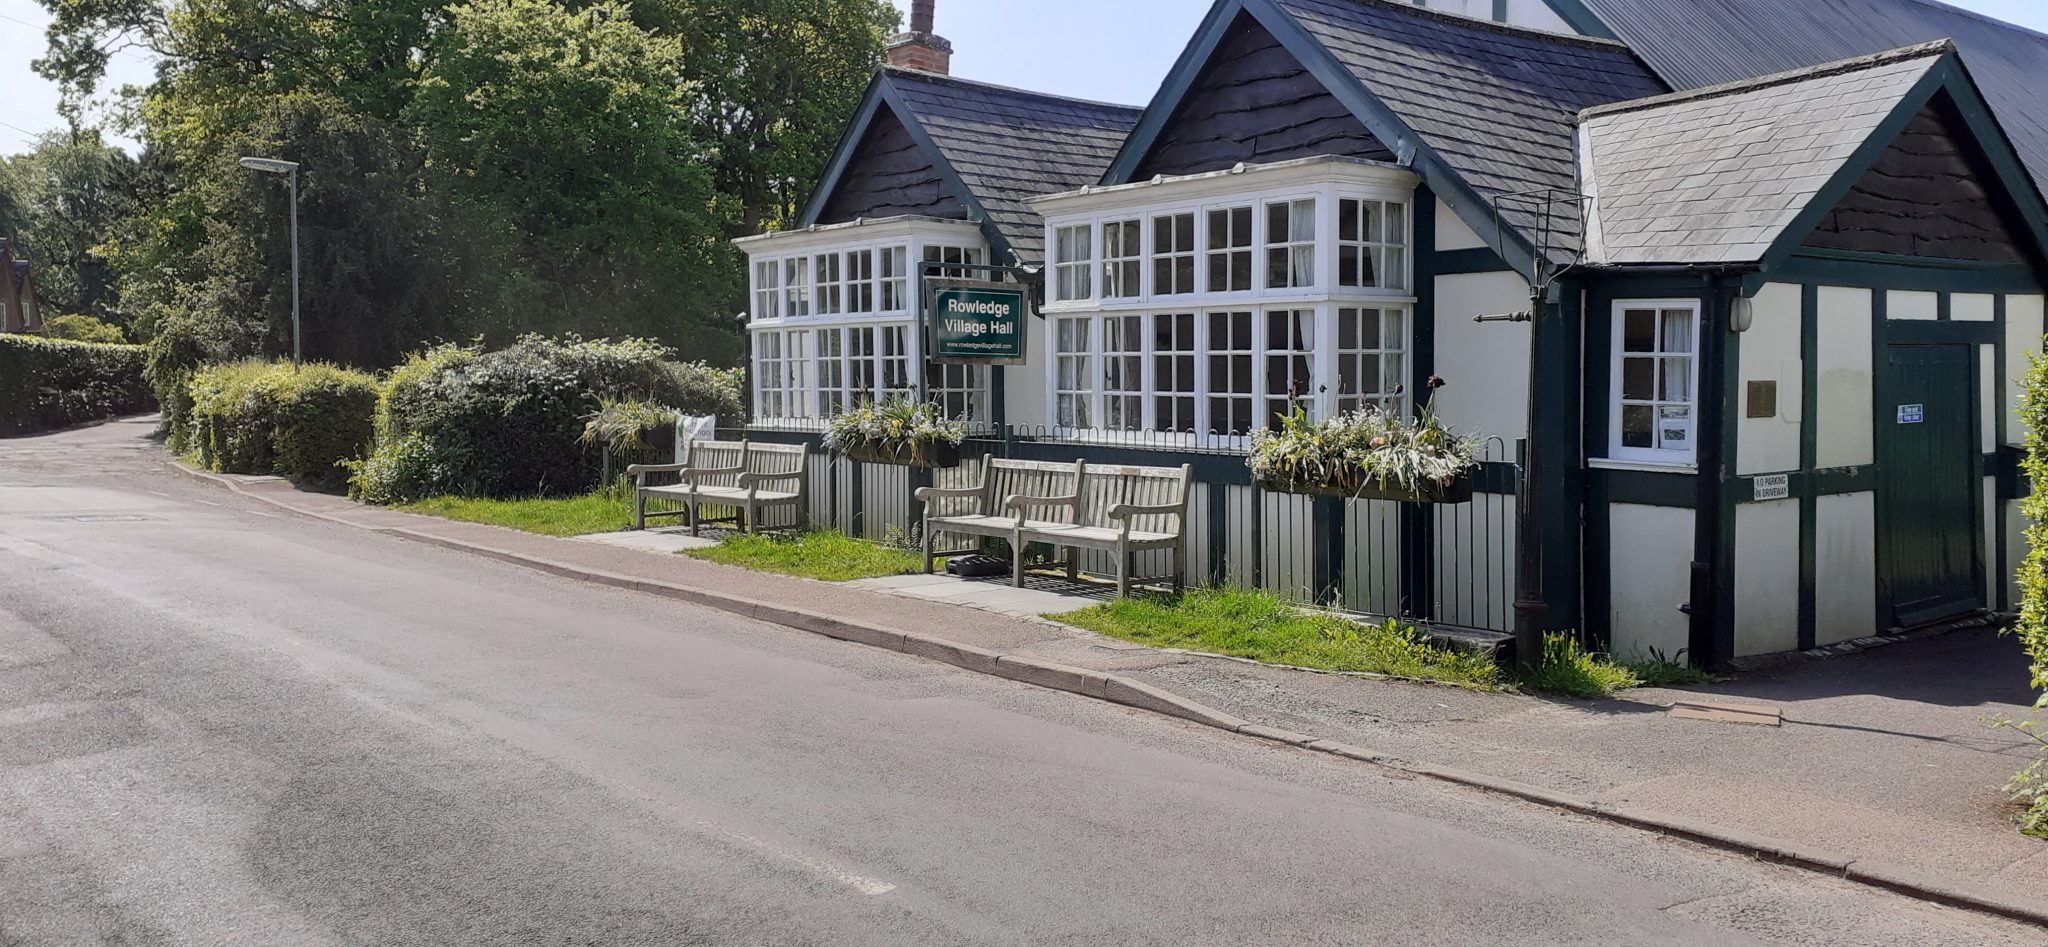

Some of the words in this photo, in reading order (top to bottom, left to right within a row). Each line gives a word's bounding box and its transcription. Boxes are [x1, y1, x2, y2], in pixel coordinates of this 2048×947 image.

[948, 299, 1010, 317] Rowledge
[944, 319, 987, 336] Village
[990, 320, 1013, 334] Hall
[1764, 476, 1786, 486] PARKING
[1762, 487, 1787, 497] DRIVEWAY
